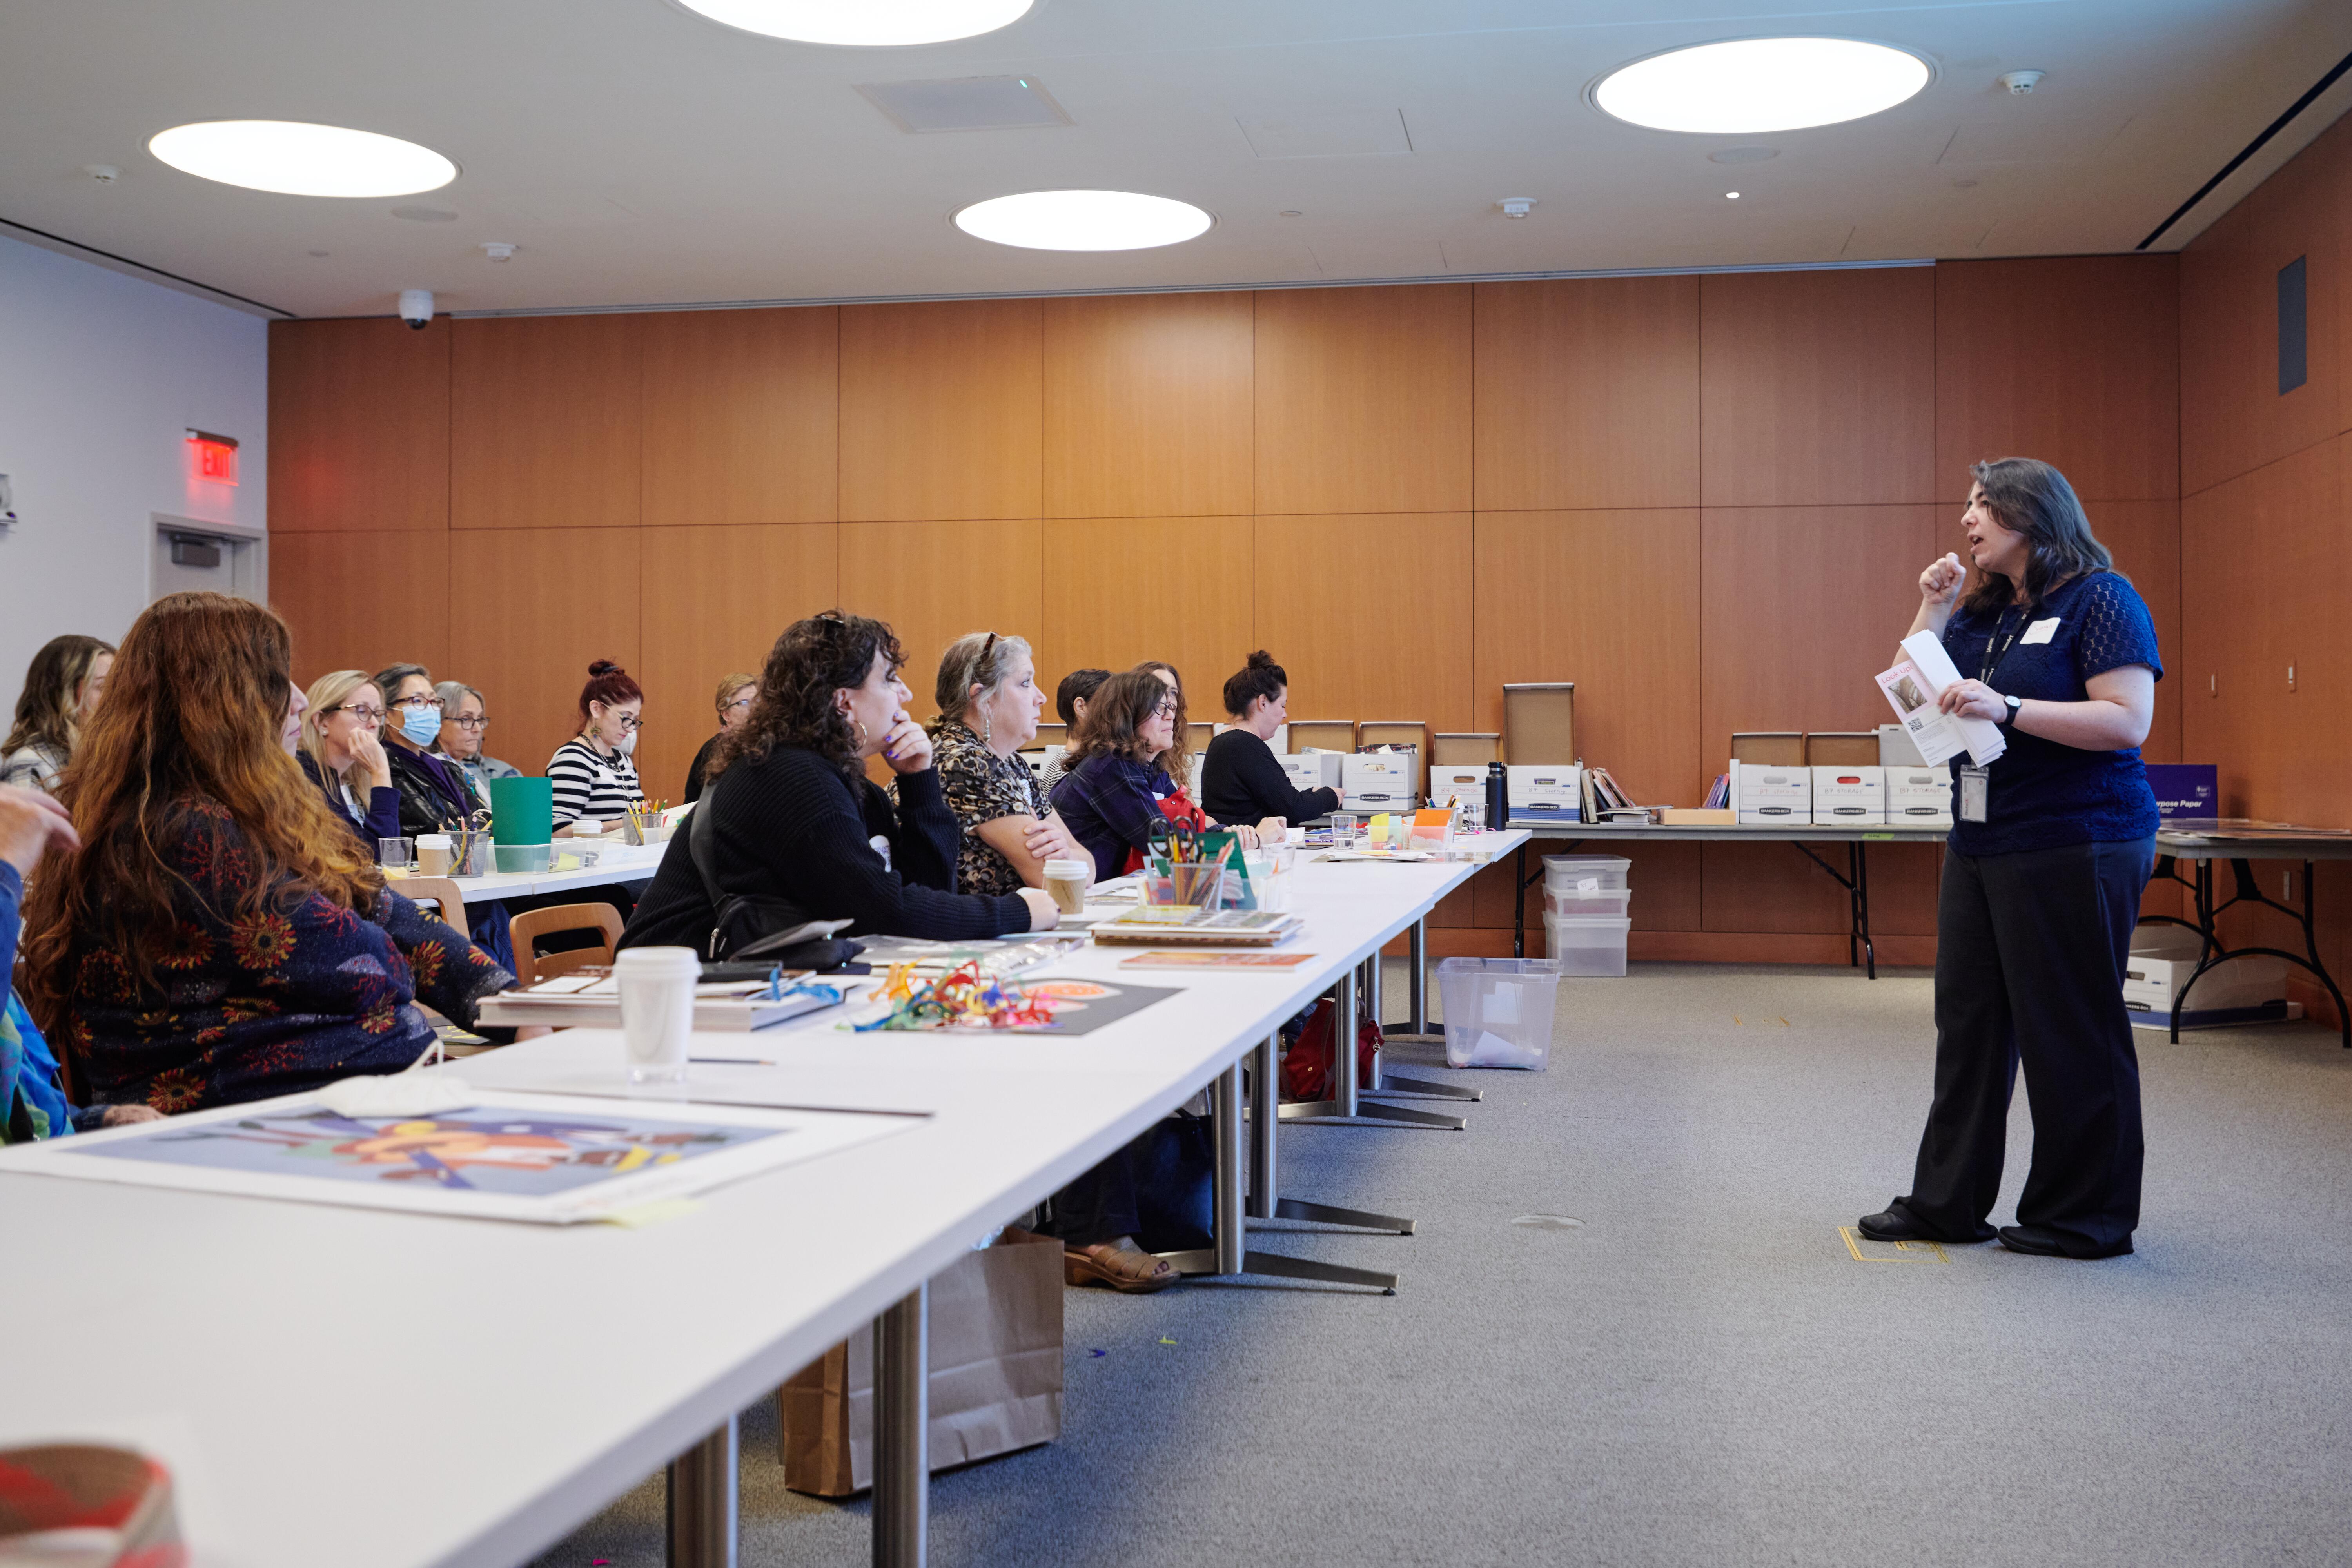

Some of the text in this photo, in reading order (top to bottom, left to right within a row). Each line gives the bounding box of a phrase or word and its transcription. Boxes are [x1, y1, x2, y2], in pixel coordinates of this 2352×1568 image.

[203, 444, 232, 479] EXIT
[1881, 664, 1914, 684] Look Up!
[2180, 800, 2202, 808] Paper
